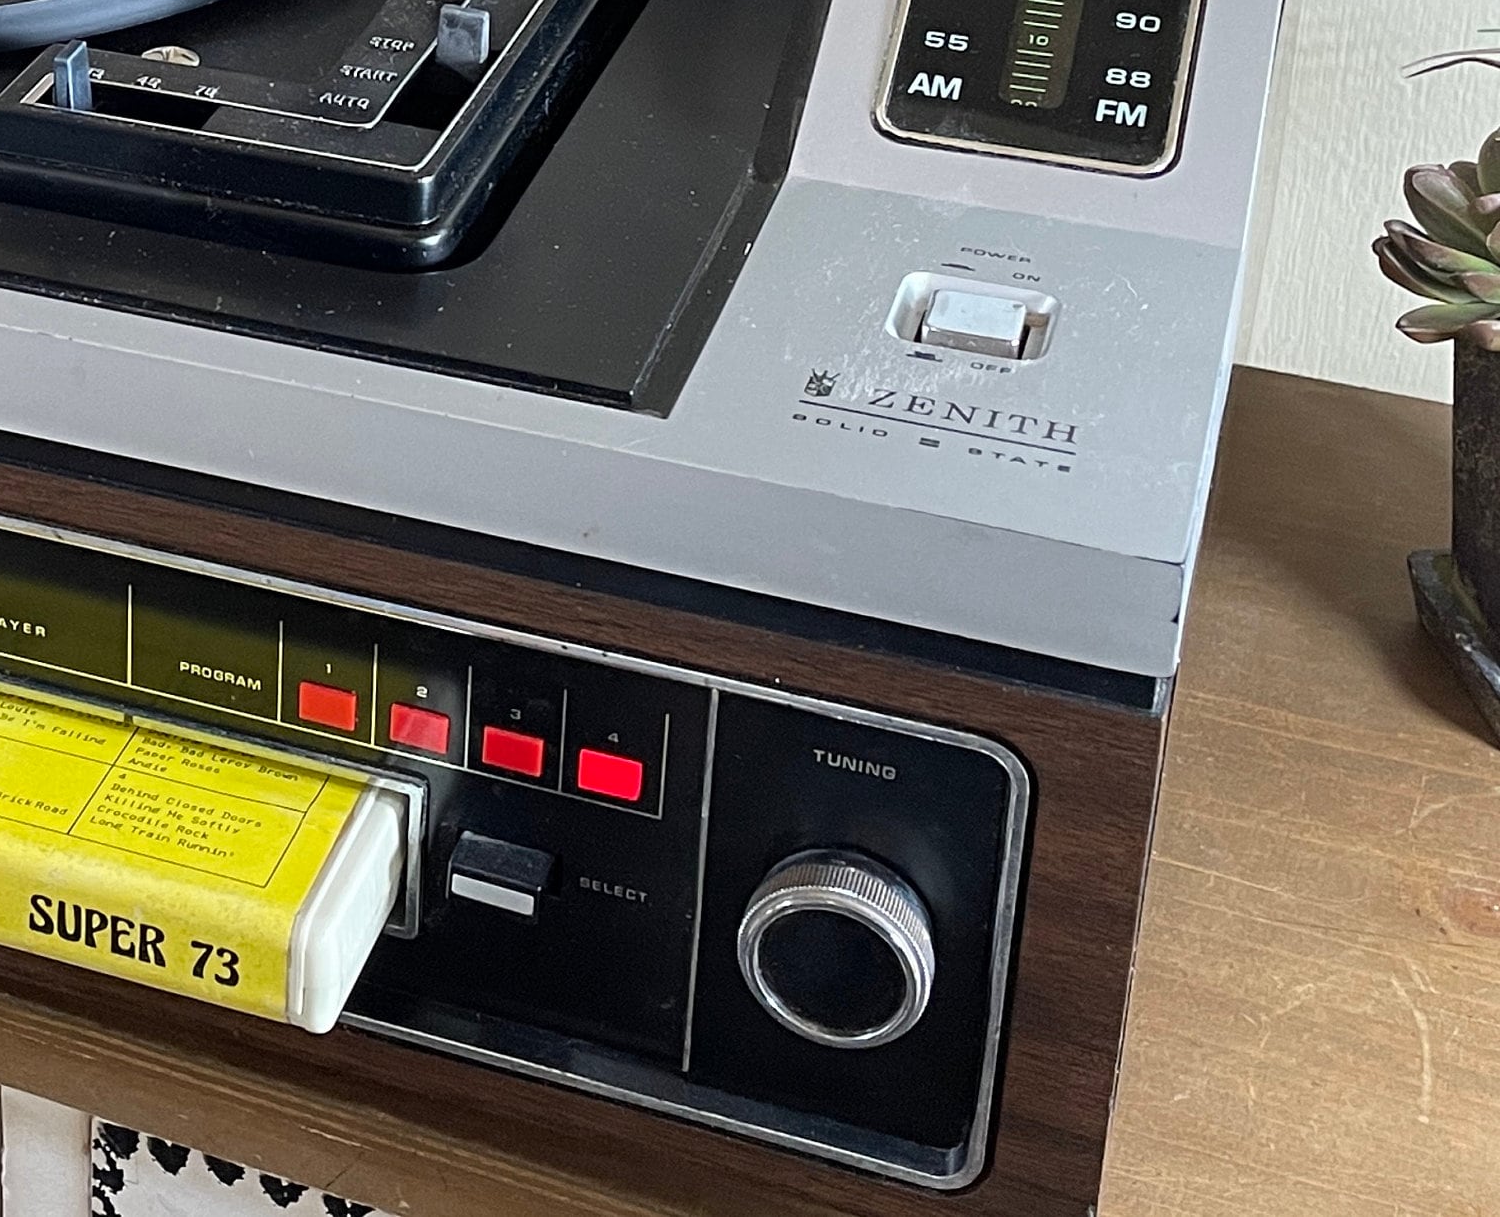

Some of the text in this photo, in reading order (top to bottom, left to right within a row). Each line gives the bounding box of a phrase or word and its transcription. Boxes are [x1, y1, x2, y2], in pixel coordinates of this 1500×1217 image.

[1115, 14, 1161, 32] 90
[369, 36, 415, 52] STOP
[924, 32, 969, 51] 55
[1029, 35, 1049, 46] 10
[340, 65, 398, 82] START
[1105, 69, 1151, 87] 88
[907, 73, 962, 100] AM
[319, 92, 370, 110] AUTO
[1095, 100, 1147, 127] FM
[960, 247, 1031, 263] POWER
[1012, 273, 1040, 282] ON
[970, 362, 1012, 373] OFF
[869, 389, 1079, 443] ZENITH
[792, 414, 1071, 472] SOLID STATE
[179, 661, 262, 692] PROGRAM
[326, 663, 332, 674] 1
[416, 686, 428, 698] 2
[510, 709, 521, 720] 3
[608, 732, 620, 744] 4
[180, 744, 204, 758] Bad
[813, 749, 896, 780] TUNING
[166, 796, 214, 816] Closed
[222, 811, 262, 828] Doors
[97, 804, 209, 840] Crocodile Rock
[192, 816, 241, 835] Softly
[132, 826, 170, 843] Train
[580, 877, 648, 903] SELECT
[29, 894, 240, 987] SUPER 73
